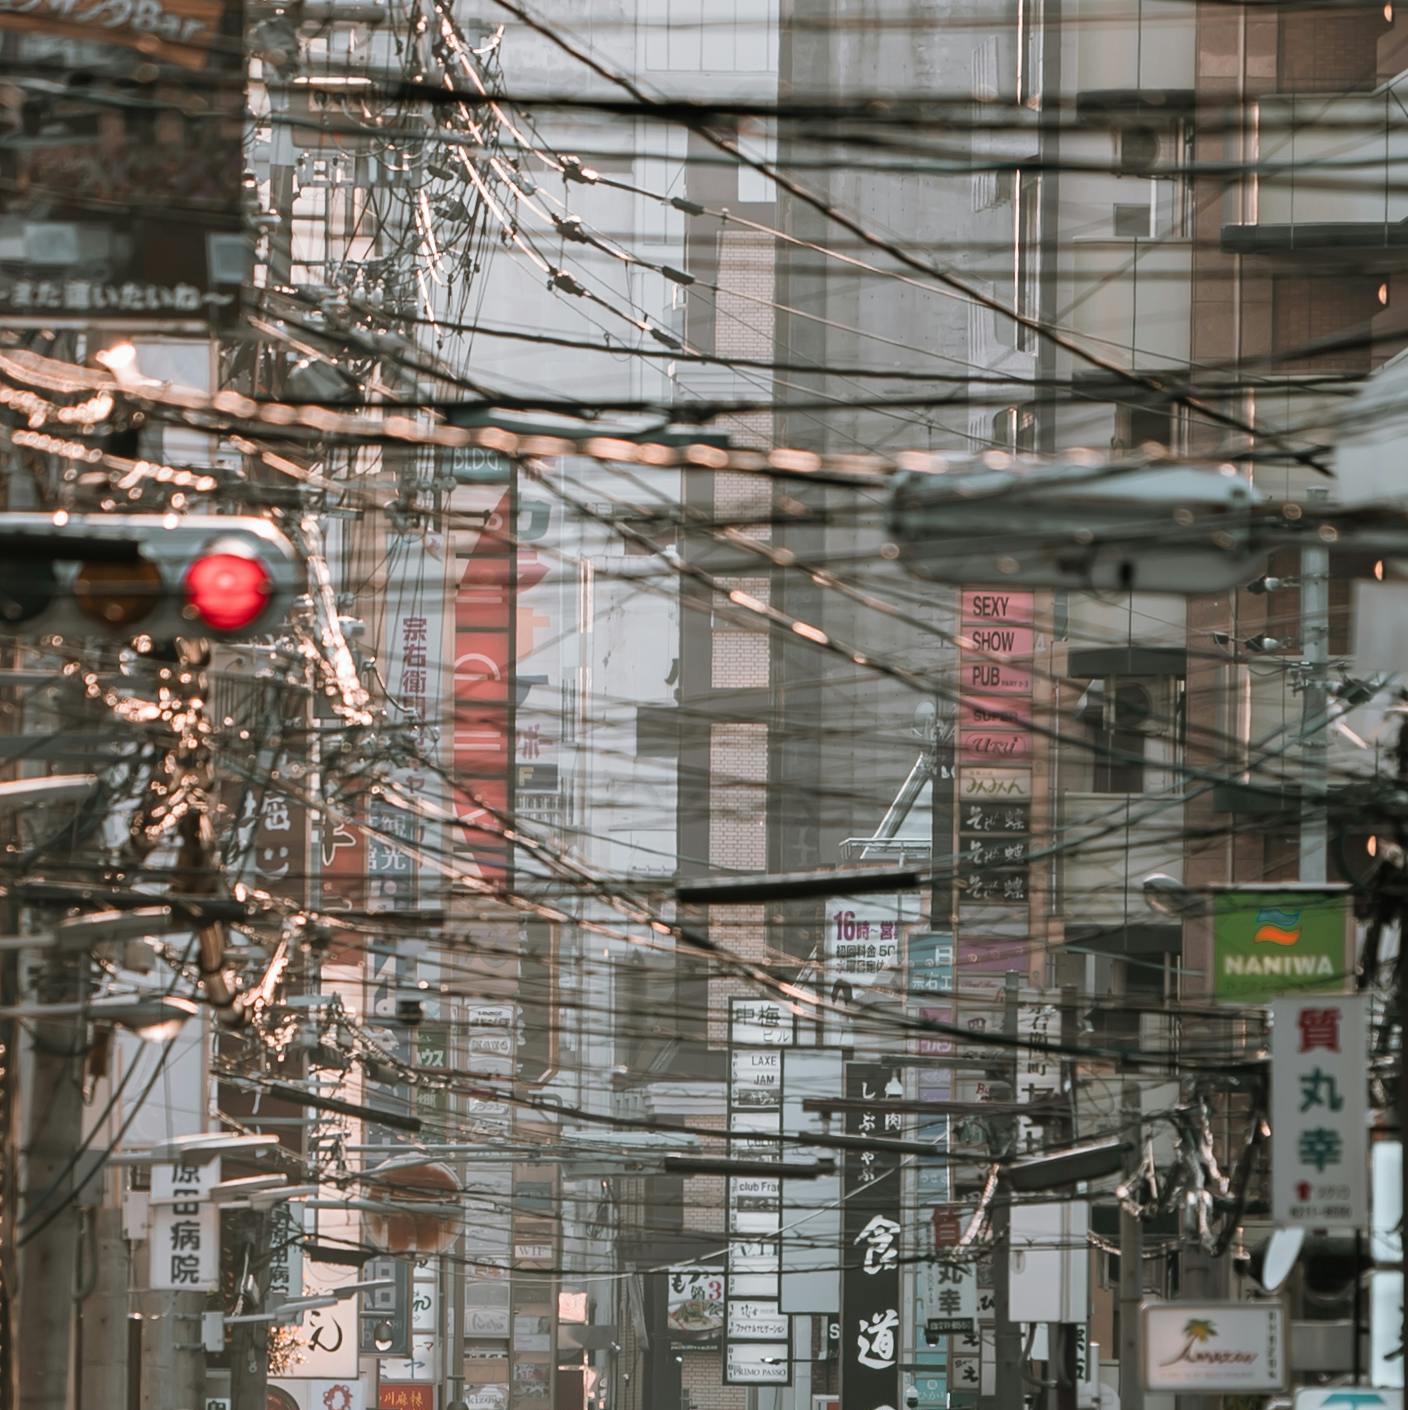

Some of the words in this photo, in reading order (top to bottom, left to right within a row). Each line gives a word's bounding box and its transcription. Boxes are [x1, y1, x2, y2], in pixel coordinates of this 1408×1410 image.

[973, 596, 1009, 617] SEXY
[973, 631, 1015, 652] SHOW
[973, 665, 1001, 687] PUB
[1224, 953, 1335, 976] NANIWA
[751, 1055, 777, 1066] LAXE
[753, 1075, 775, 1086] JAM
[739, 1180, 759, 1191] club
[762, 1367, 786, 1377] PASSO
